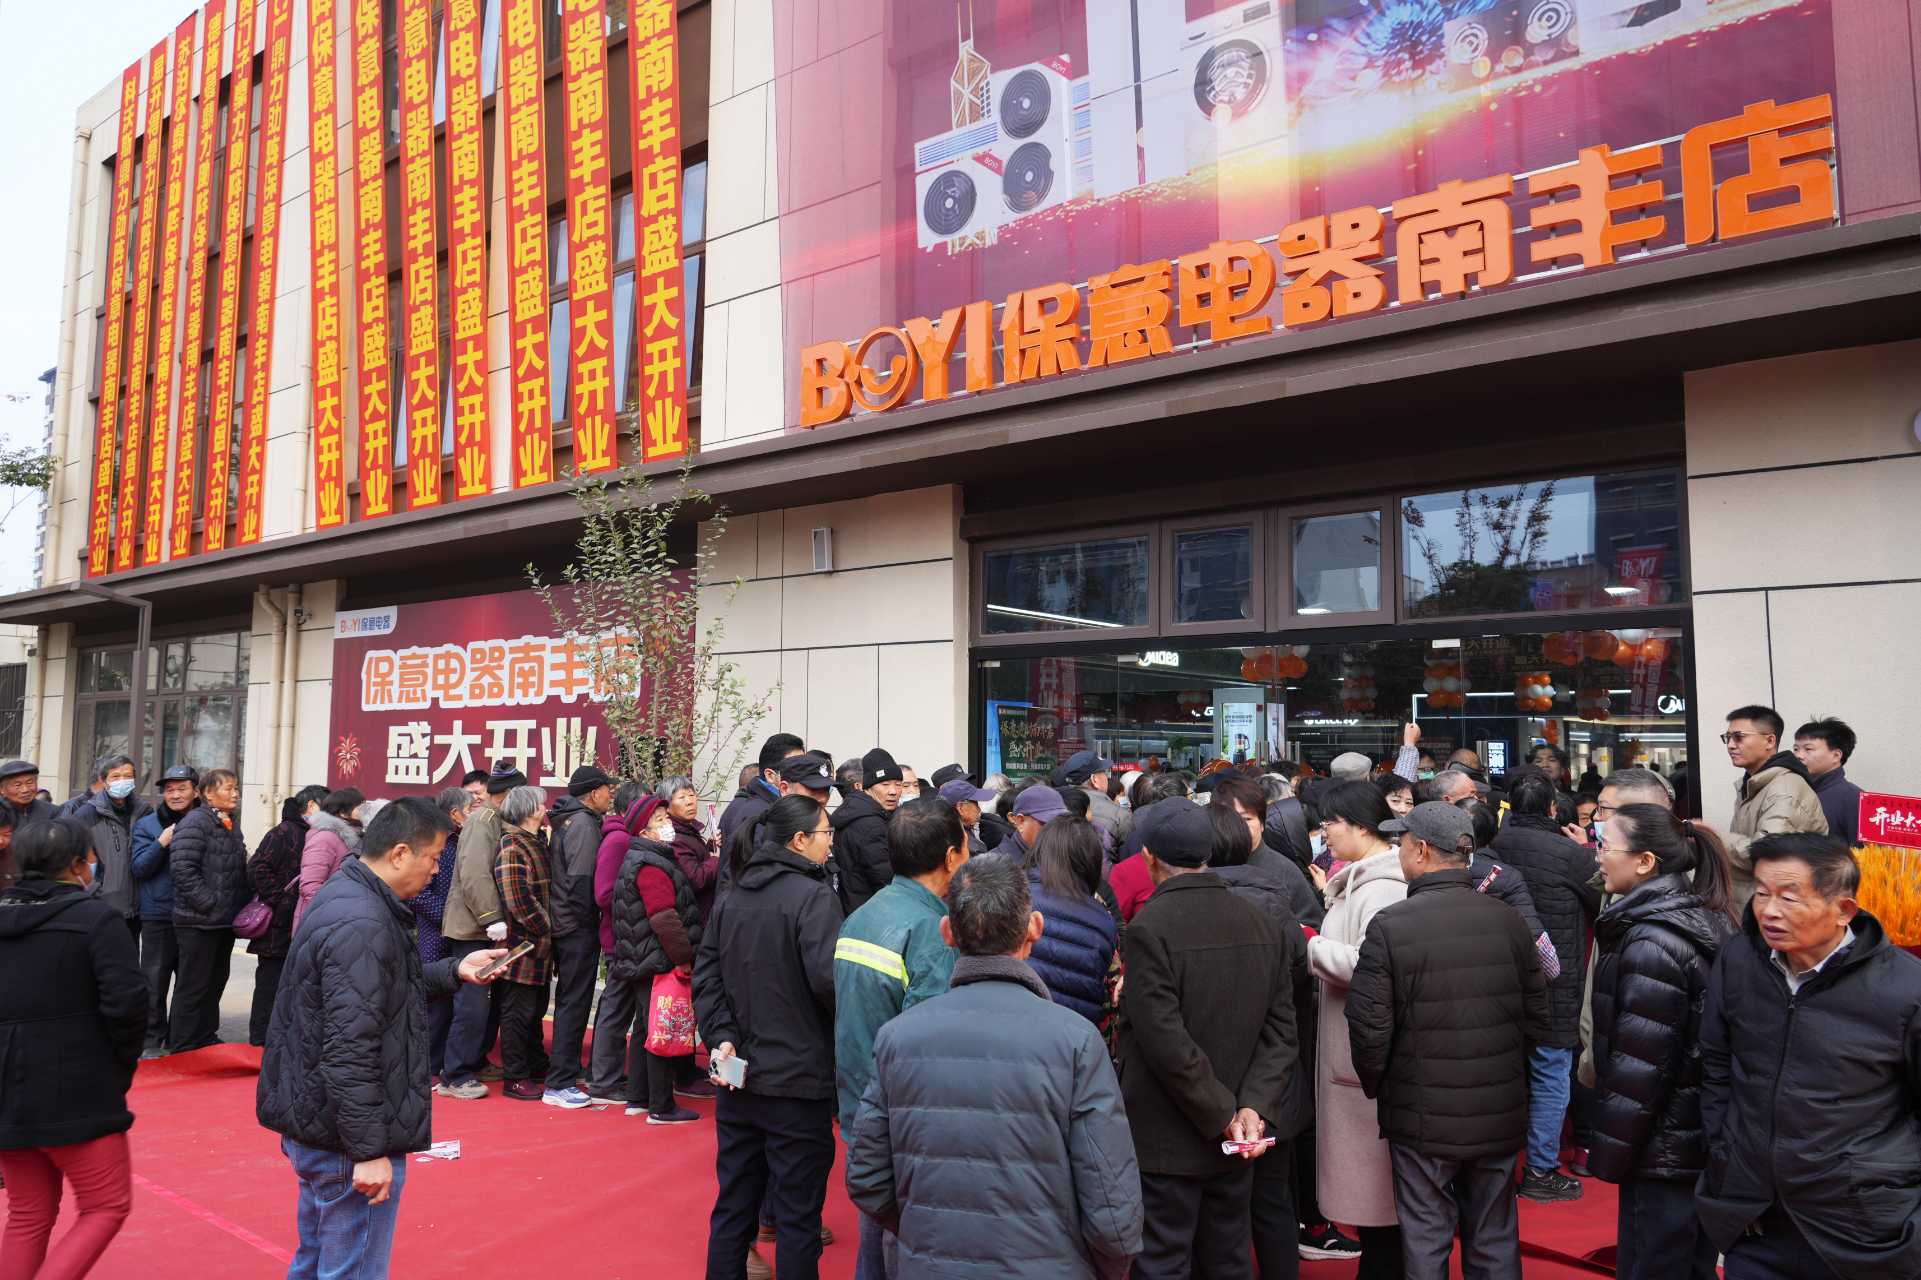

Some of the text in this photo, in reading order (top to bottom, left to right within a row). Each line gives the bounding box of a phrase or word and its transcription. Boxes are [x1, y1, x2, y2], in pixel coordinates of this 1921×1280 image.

[404, 0, 438, 507] 意电器南丰店盛大开业
[566, 0, 611, 472] 器南丰店盛大开业
[1000, 93, 1834, 386] 保意电器南丰店
[385, 717, 598, 788] 盛大开业
